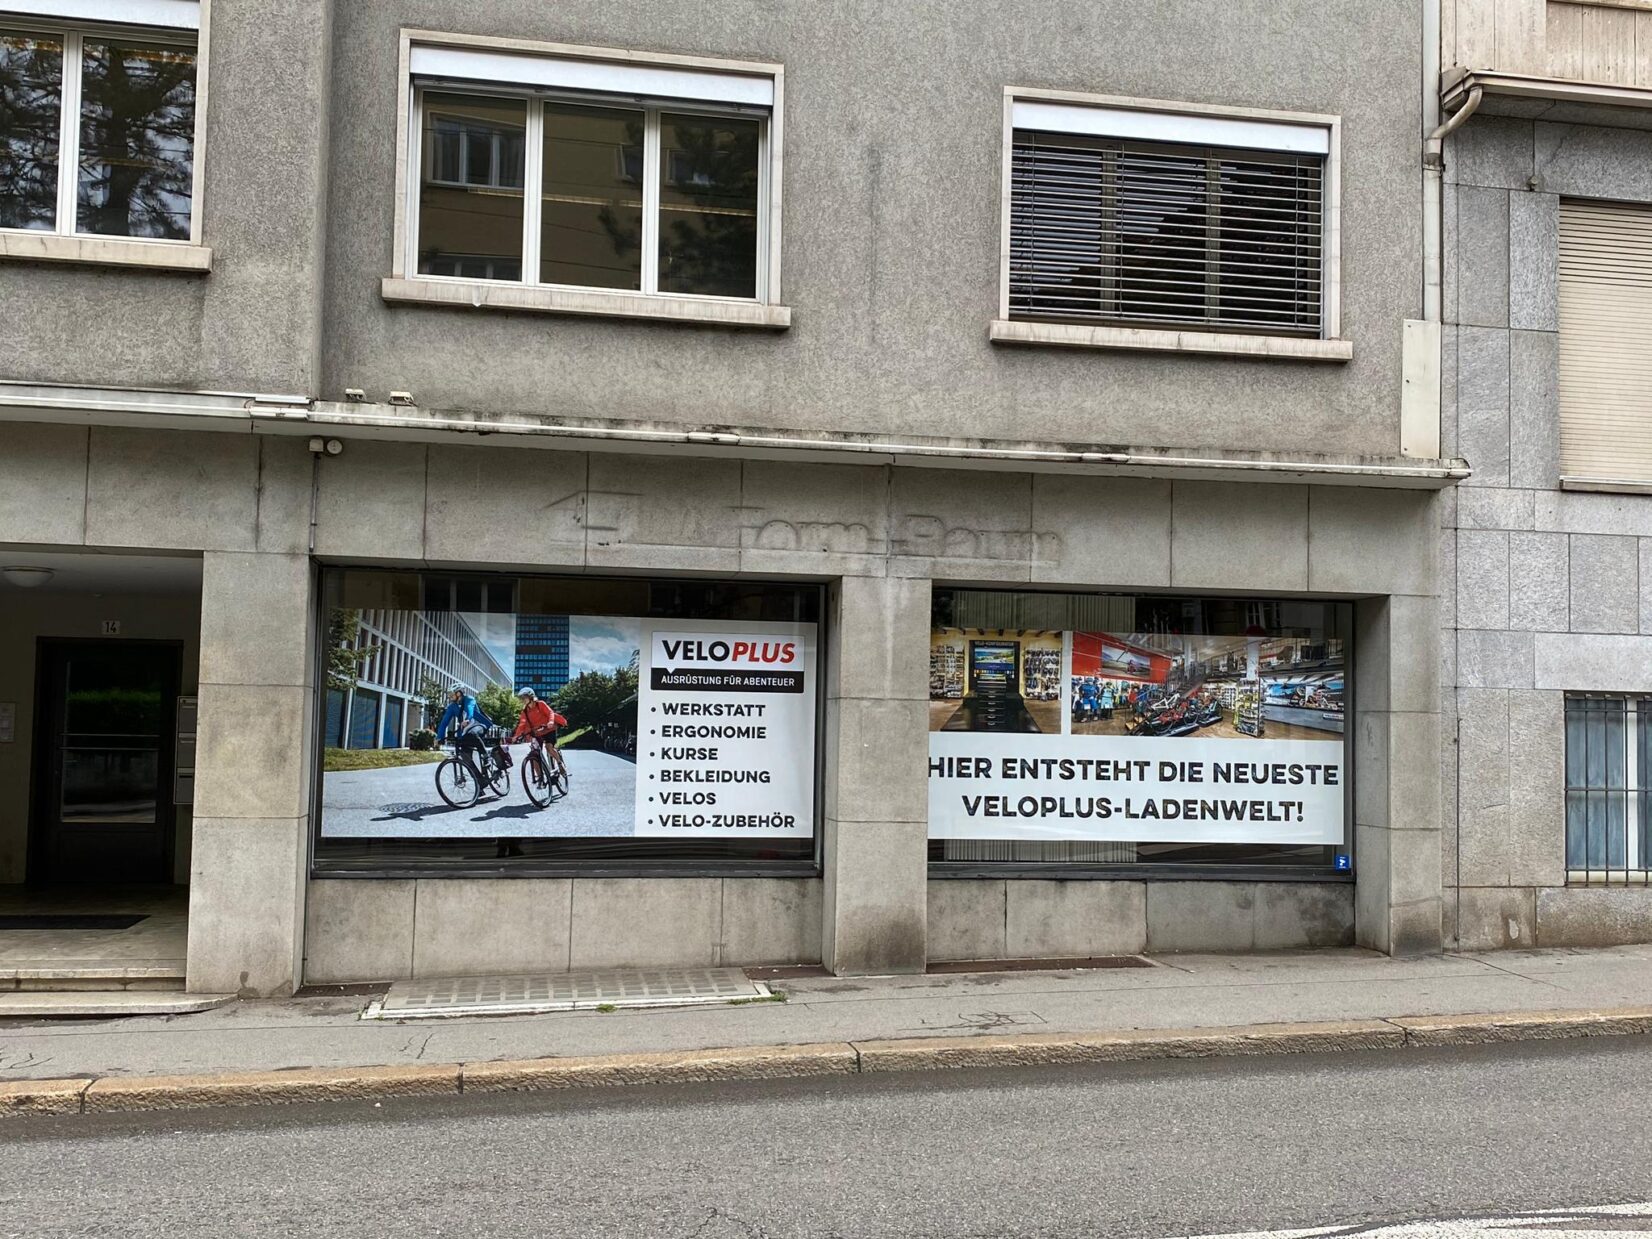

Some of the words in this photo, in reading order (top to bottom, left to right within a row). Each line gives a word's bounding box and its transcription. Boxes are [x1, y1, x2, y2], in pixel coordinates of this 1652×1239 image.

[105, 620, 117, 633] 14
[662, 640, 795, 664] VELOPLUS
[661, 674, 722, 685] AUSRÜSTUNG
[723, 675, 742, 686] FÜR
[743, 678, 795, 687] ABENTEUER
[662, 703, 766, 717] WERKSTATT
[661, 725, 767, 739] ERGONOMIE
[661, 748, 718, 761] KURSE
[660, 770, 771, 783] BEKLEIDUNG
[928, 757, 992, 779] HIER
[1002, 758, 1150, 782] ENTSTEHT
[1159, 761, 1204, 782] DIE
[1213, 762, 1339, 785] NEUESTE
[659, 792, 717, 805] VELOS
[961, 796, 1304, 822] VELOPLUS-LADENWELT!
[659, 812, 795, 828] VELO-ZUBEHÖR
